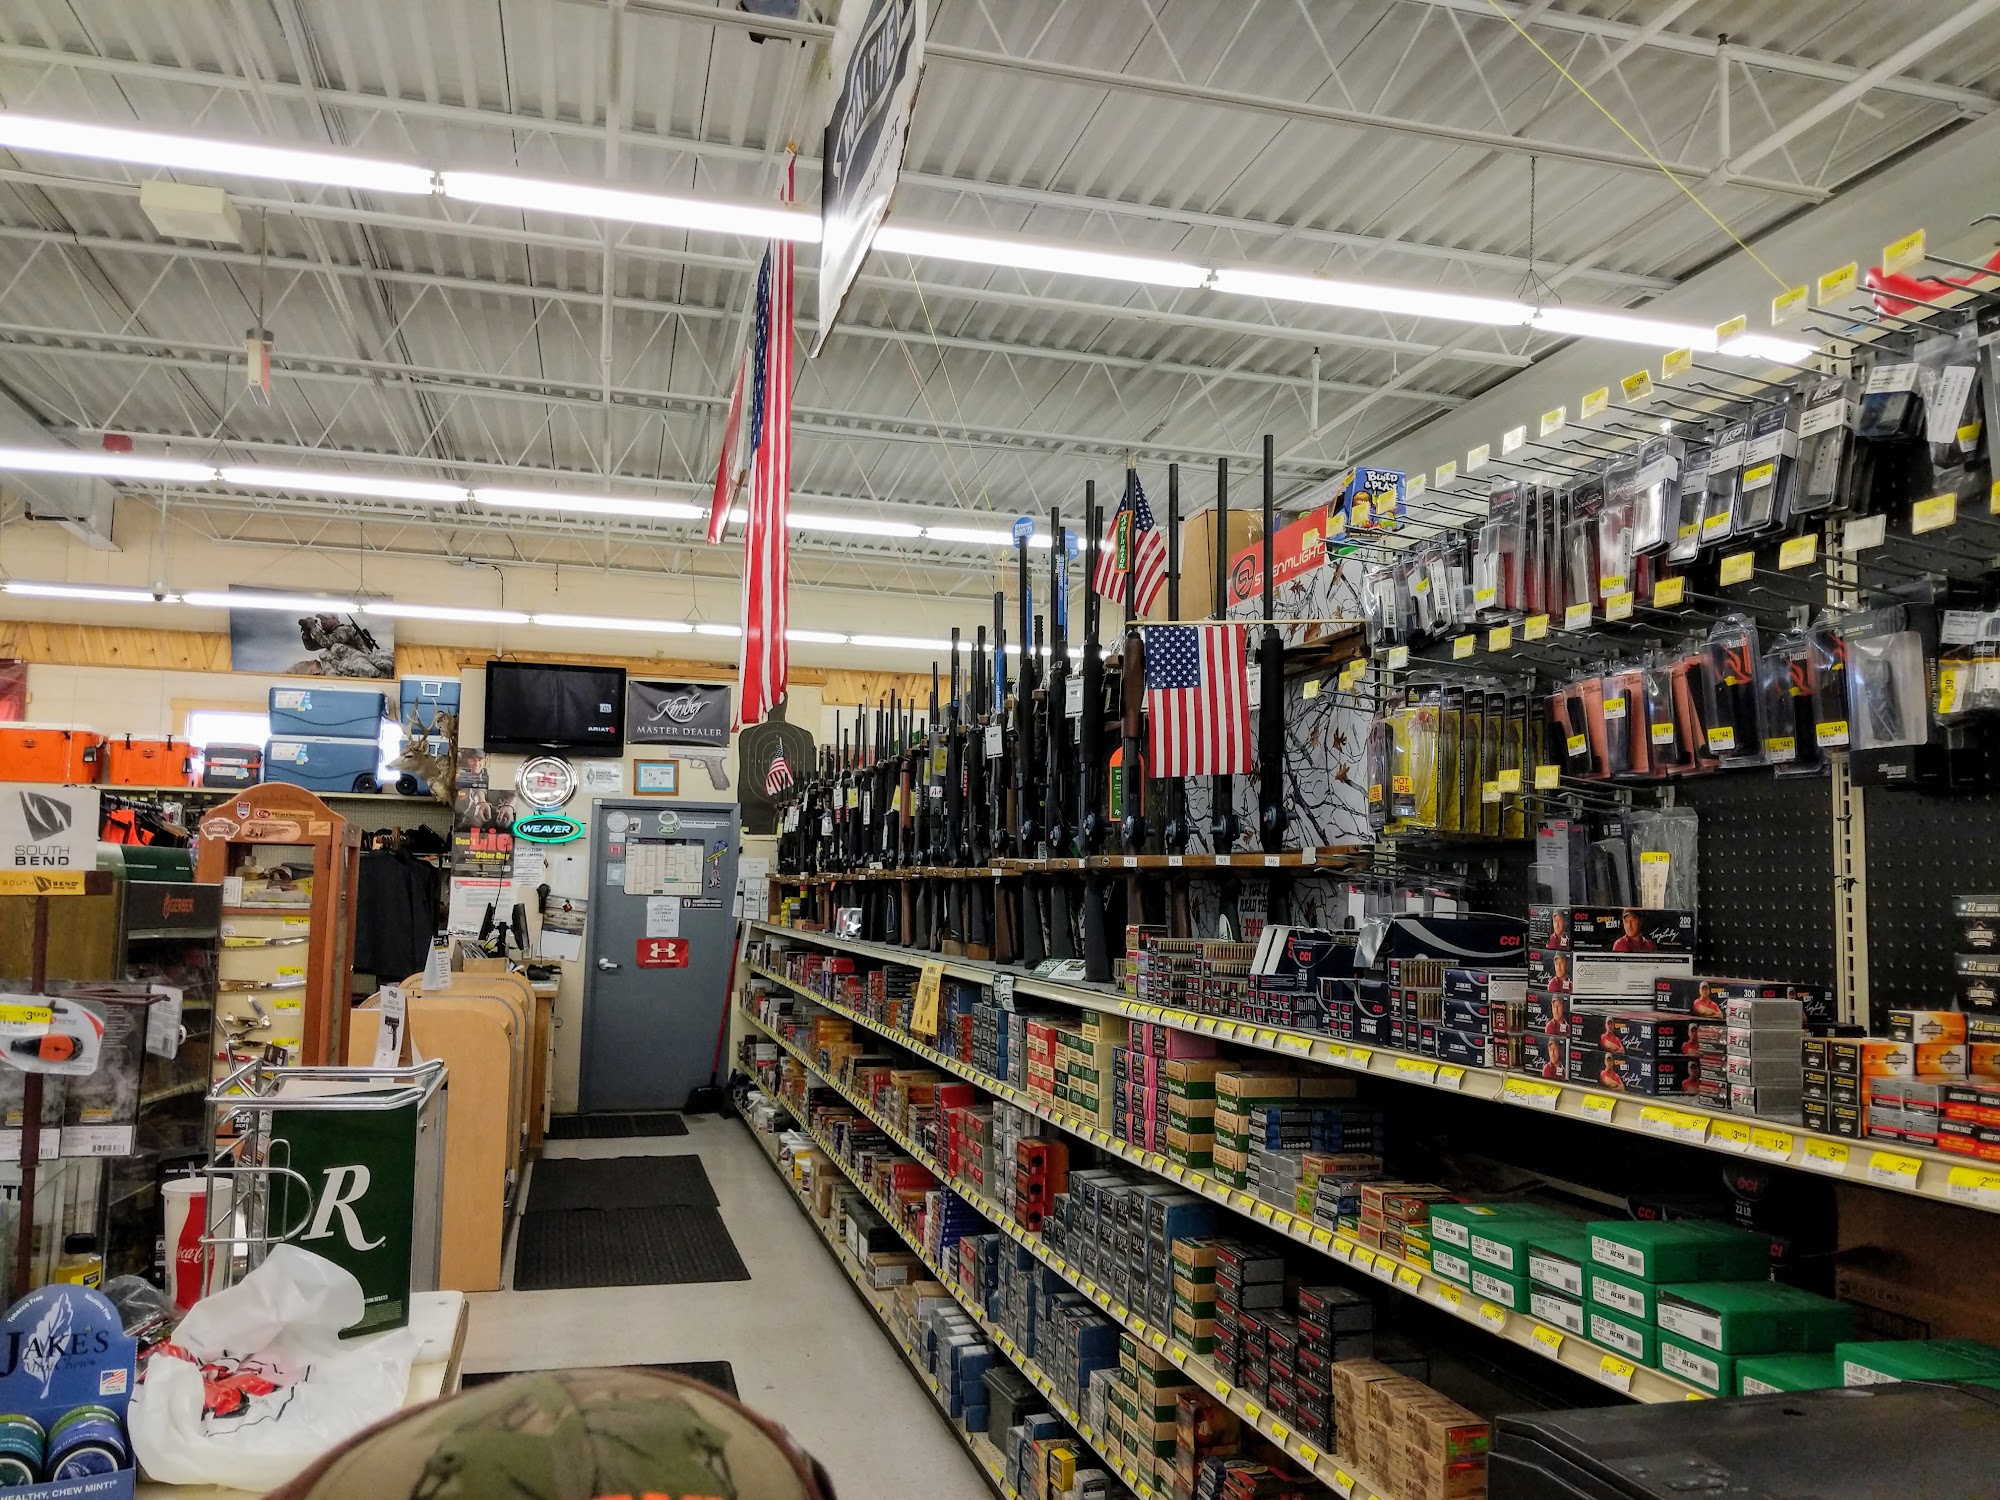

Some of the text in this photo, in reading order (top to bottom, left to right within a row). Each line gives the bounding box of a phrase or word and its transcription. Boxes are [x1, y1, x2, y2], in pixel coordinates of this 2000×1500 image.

[1254, 541, 1326, 587] STEAMLIGHT
[648, 693, 711, 723] Kimber
[637, 726, 722, 737] MASTER DEALER
[1393, 777, 1409, 785] HOT
[1393, 785, 1410, 793] LIPS
[522, 825, 571, 834] WEAVER
[455, 827, 513, 851] Don't Lie
[15, 845, 69, 855] SOUTH
[15, 856, 69, 866] BEND
[1680, 916, 1691, 924] 200
[1500, 936, 1520, 946] CCI
[1299, 951, 1311, 961] CCI
[1744, 989, 1755, 998] 300
[1373, 1004, 1382, 1013] CCI
[1641, 1026, 1651, 1034] 300
[1975, 1020, 1983, 1030] 22
[1641, 1064, 1651, 1072] 300
[1737, 1177, 1757, 1192] CCI
[300, 1164, 387, 1251] R
[1637, 1206, 1655, 1220] CCI
[1610, 1250, 1625, 1260] RCBS
[1770, 1243, 1783, 1257] CI
[1611, 1291, 1625, 1300] RCBS
[7, 1295, 44, 1323] Tobacco Free
[1610, 1330, 1624, 1341] RCBS
[0, 1325, 109, 1377] JAKE'S
[1682, 1359, 1698, 1370] RCBS
[52, 1486, 85, 1498] CHEW
